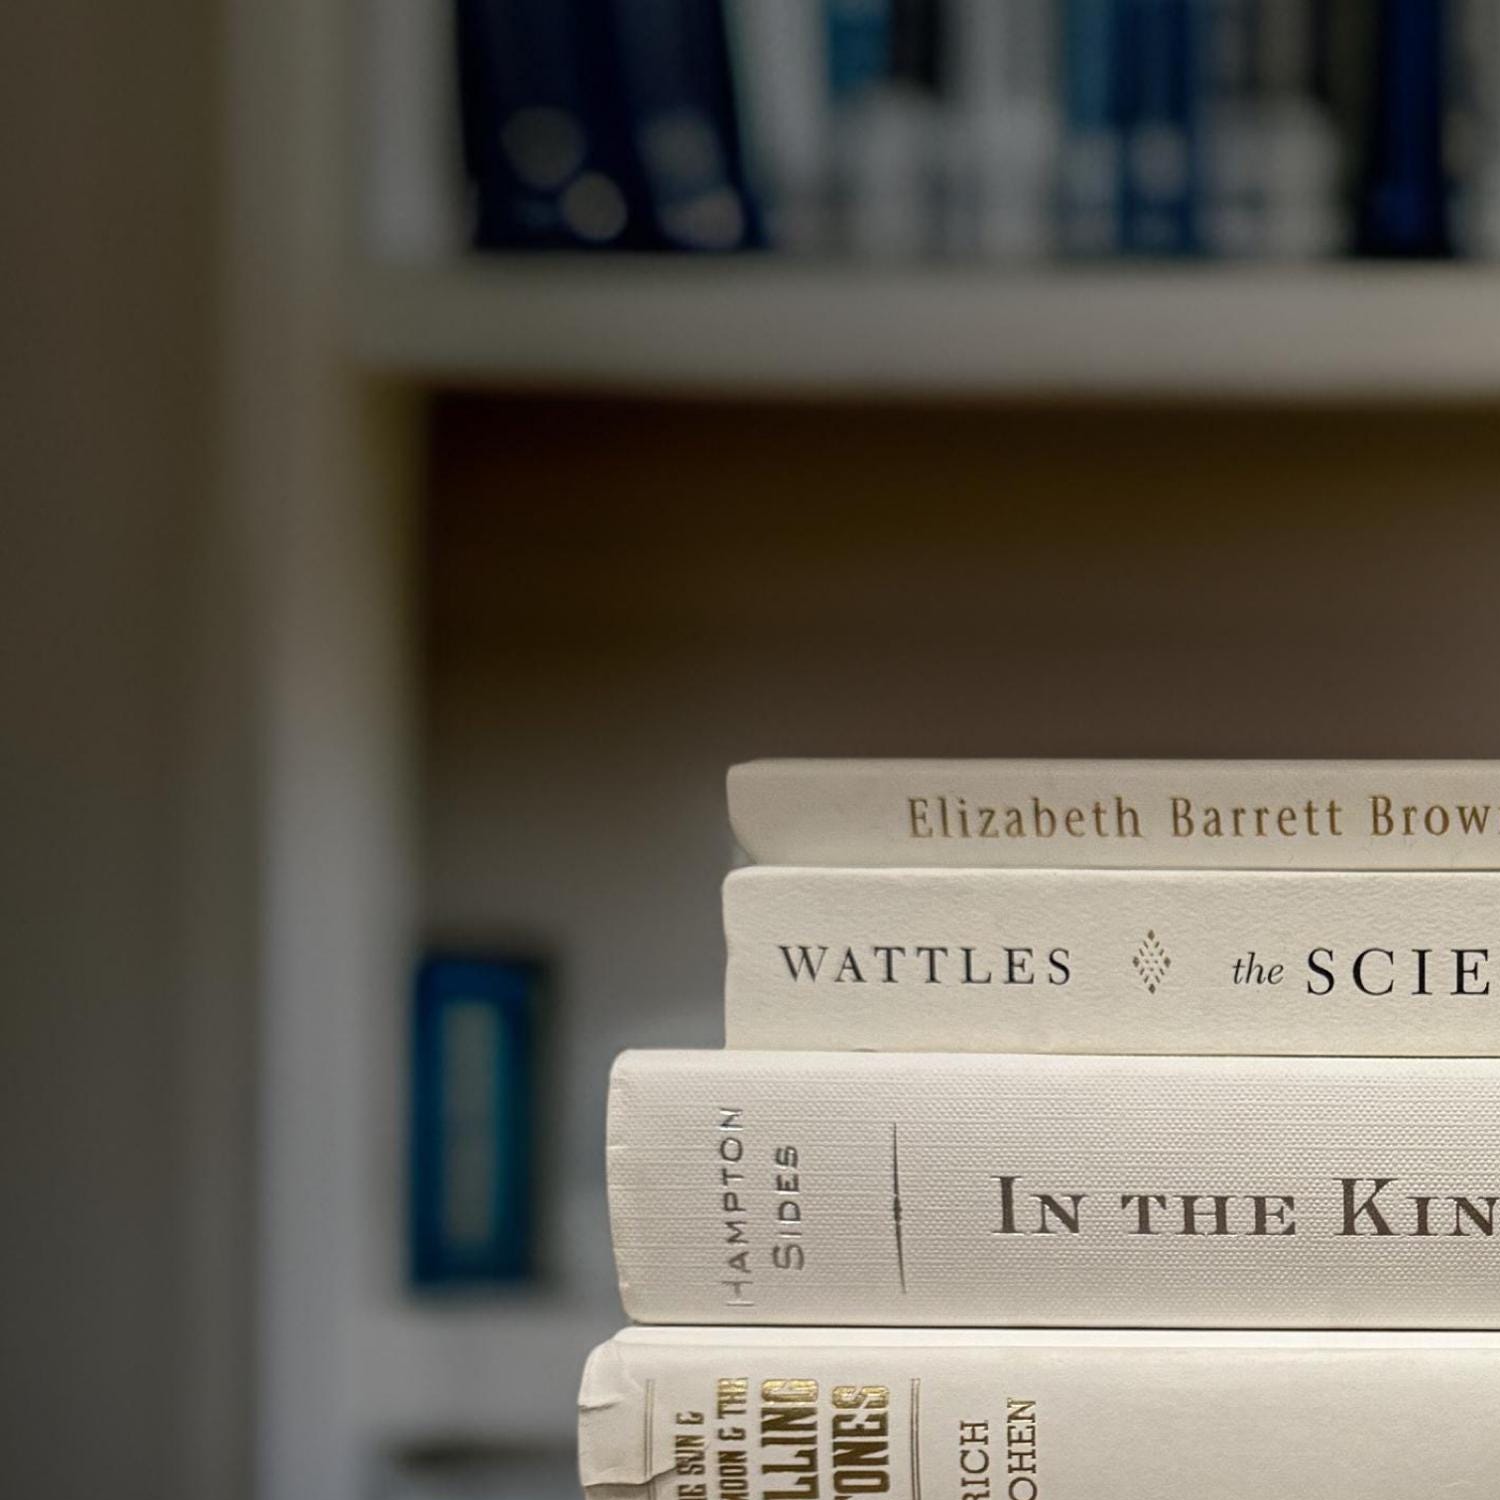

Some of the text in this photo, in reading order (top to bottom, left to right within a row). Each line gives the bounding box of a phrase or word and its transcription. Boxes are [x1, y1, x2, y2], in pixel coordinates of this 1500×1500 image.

[907, 795, 1145, 840] Elizabeth
[1170, 796, 1344, 837] Barrett
[778, 944, 1074, 985] WATTLES
[1230, 952, 1286, 986] the
[719, 1107, 754, 1307] HAMPTON
[772, 1145, 805, 1271] SIDES
[1120, 1193, 1297, 1236] THE
[717, 1377, 749, 1419] THE
[675, 1434, 708, 1477] SUN
